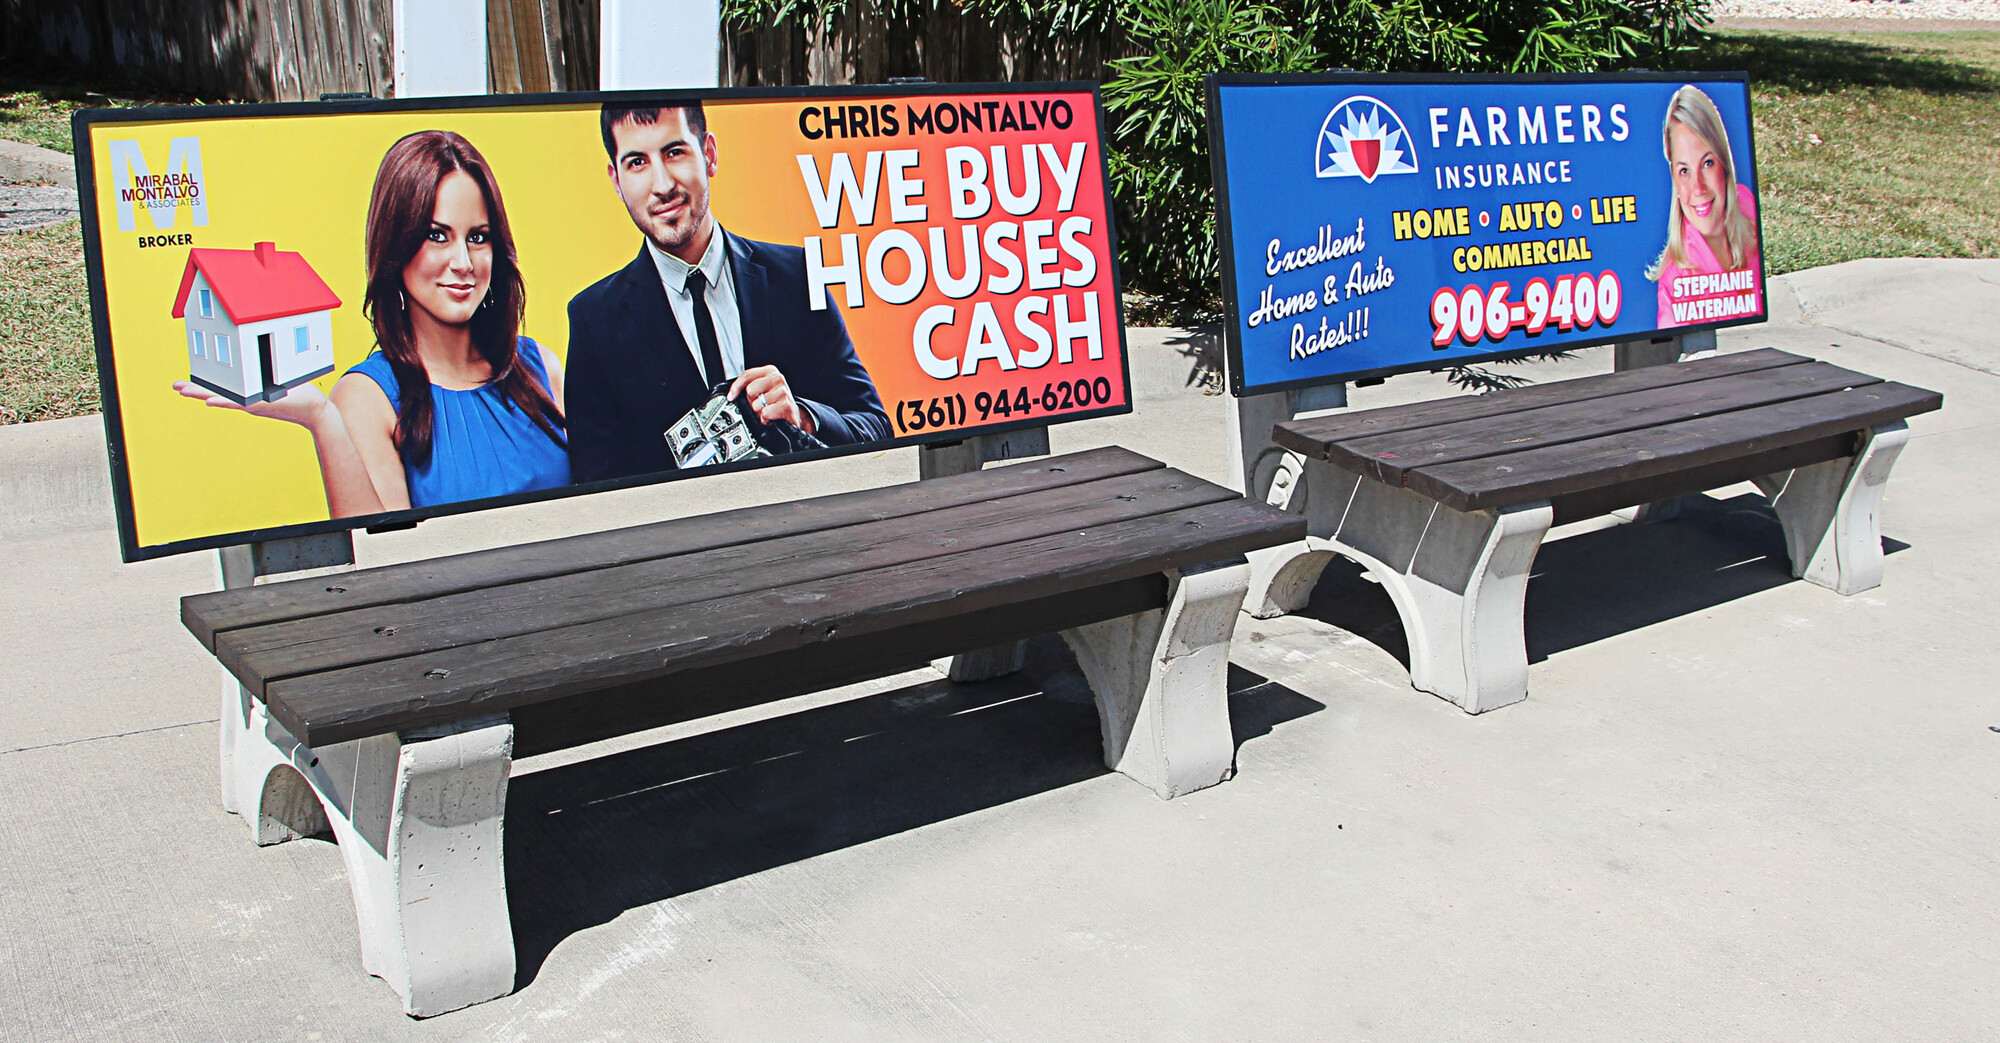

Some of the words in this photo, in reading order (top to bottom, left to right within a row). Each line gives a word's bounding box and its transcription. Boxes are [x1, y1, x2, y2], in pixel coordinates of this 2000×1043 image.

[799, 103, 900, 140] CHRIS
[907, 99, 1073, 135] MONTALVO
[1428, 103, 1630, 148] FARMERS
[108, 136, 210, 232] M
[122, 185, 199, 202] MONTALVO
[135, 173, 198, 188] MIRABAL
[796, 149, 928, 228] WE
[945, 142, 1087, 219] BUY
[1435, 160, 1572, 190] INSURANCE
[138, 201, 145, 209] &
[147, 198, 200, 209] ASSOCIATES
[1392, 206, 1471, 240] HOME
[1498, 200, 1563, 233] AUTO
[1590, 195, 1638, 225] LIFE
[138, 233, 193, 248] BROKER
[1266, 217, 1366, 276] Excellent
[1452, 237, 1592, 273] COMMERCIAL
[804, 216, 1097, 311] HOUSES
[1672, 270, 1754, 299] STEPHANIE
[1248, 284, 1318, 328] Home
[1323, 275, 1339, 305] &
[1344, 255, 1395, 300] Auto
[1430, 269, 1622, 348] 906-9400
[1671, 294, 1757, 323] WATERMAN
[912, 291, 1103, 380] CASH
[1289, 306, 1370, 361] Rates!!!
[896, 392, 967, 433] (361)
[975, 376, 1111, 420] 944-6200
